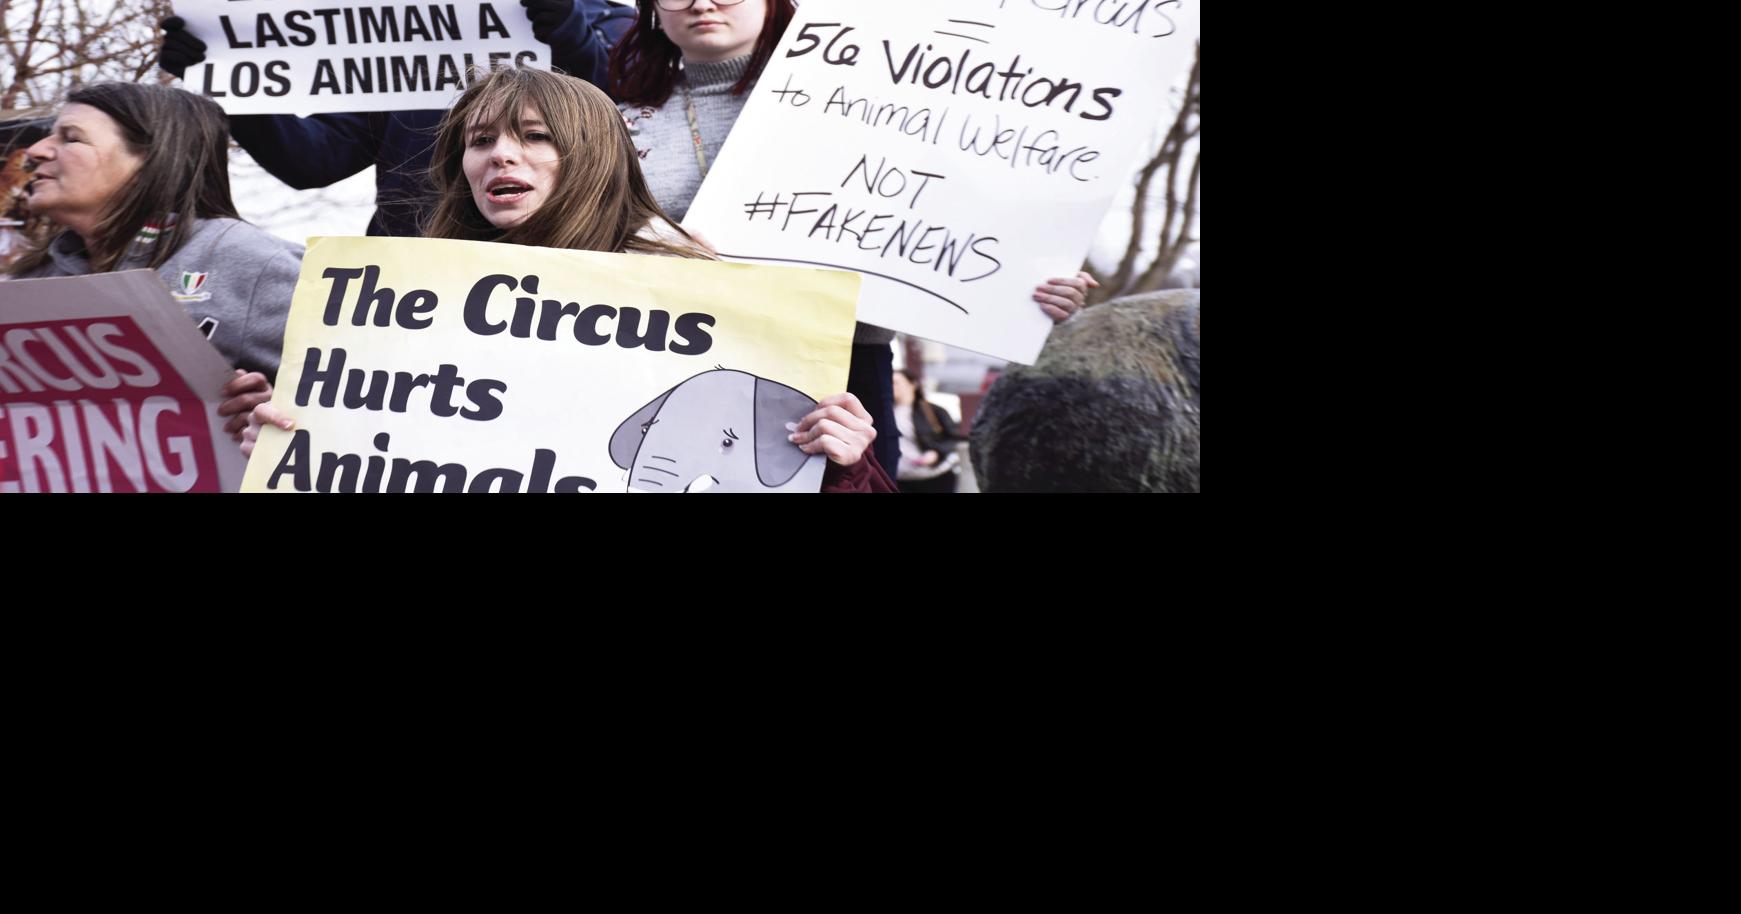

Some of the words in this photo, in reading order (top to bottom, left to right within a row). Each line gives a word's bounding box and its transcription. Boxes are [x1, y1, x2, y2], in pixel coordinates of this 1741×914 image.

[219, 4, 463, 49] LASTIMAN
[479, 2, 511, 40] A
[203, 60, 291, 98] LOS
[772, 74, 811, 107] to
[824, 86, 949, 144] Animal
[786, 22, 861, 66] 56
[882, 40, 1123, 121] Violations
[841, 154, 945, 208] NOT
[744, 191, 1002, 282] #FAKENEWS
[322, 264, 439, 330] The
[463, 274, 717, 356] Circus
[294, 347, 508, 422] Hurts
[0, 395, 200, 493] RING
